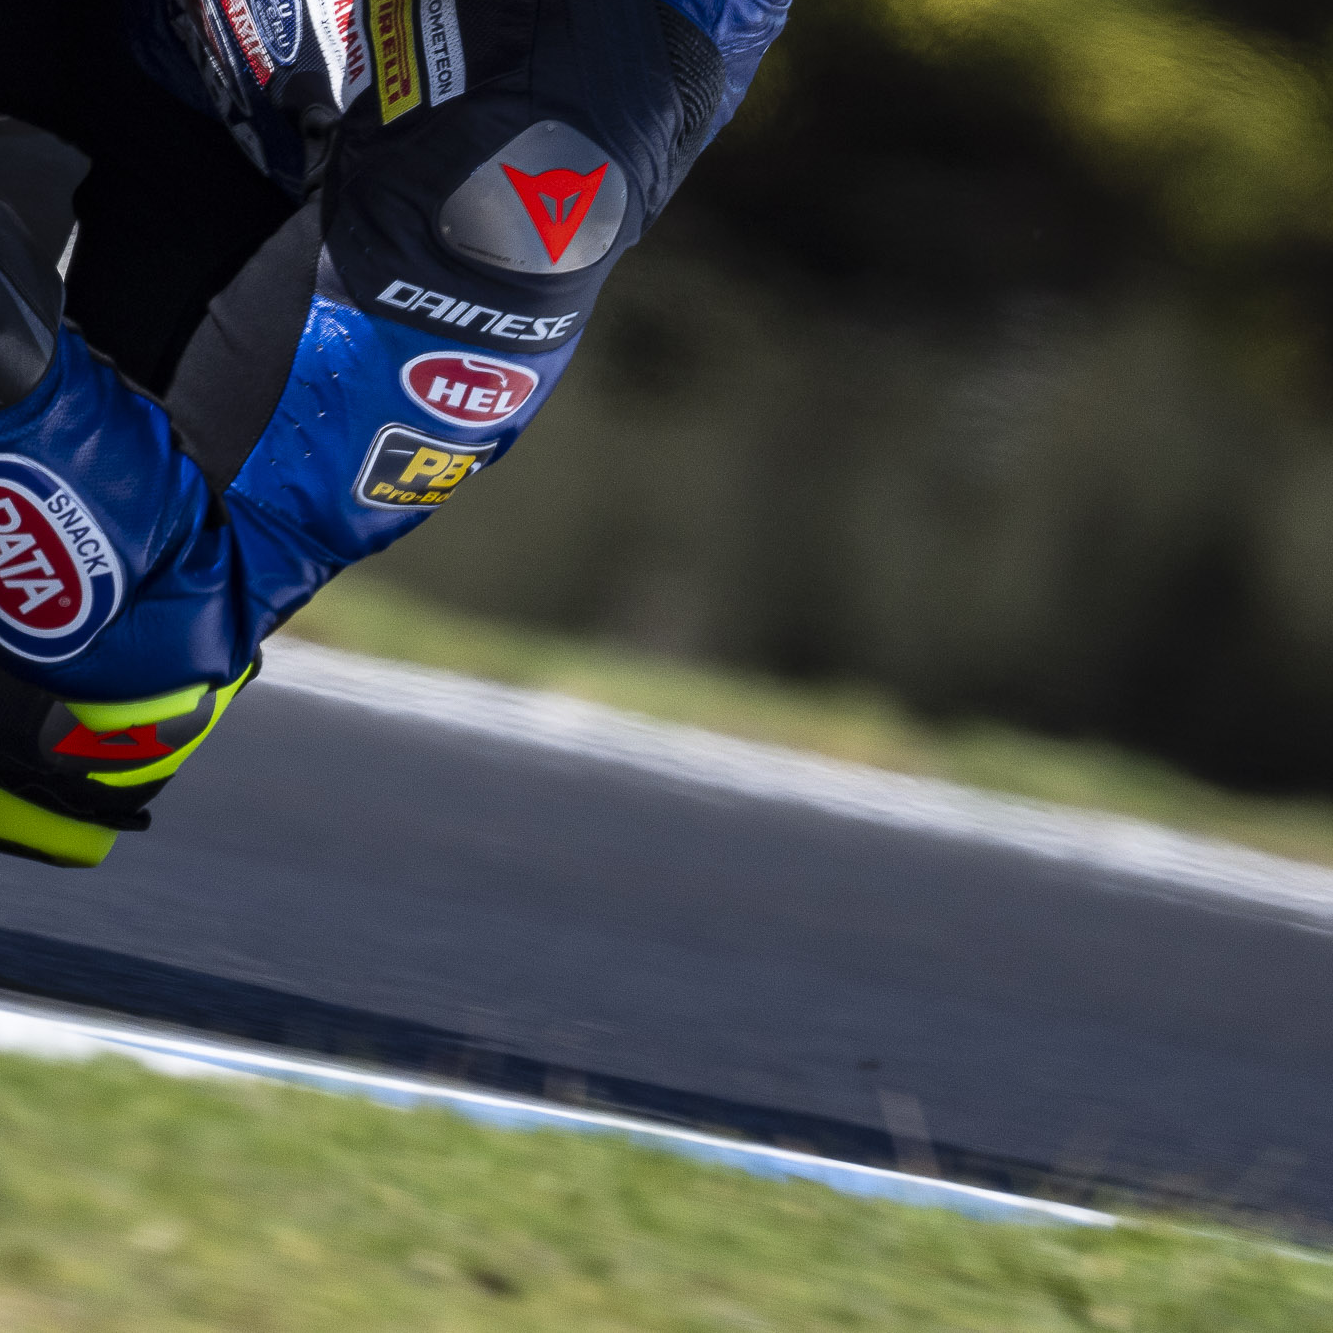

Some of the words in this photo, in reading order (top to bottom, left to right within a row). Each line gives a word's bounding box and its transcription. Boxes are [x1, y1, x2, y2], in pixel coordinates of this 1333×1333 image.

[375, 279, 579, 341] DAINESE
[427, 375, 517, 414] HEL
[370, 481, 455, 504] Pro-Bo
[47, 494, 111, 577] SNACK
